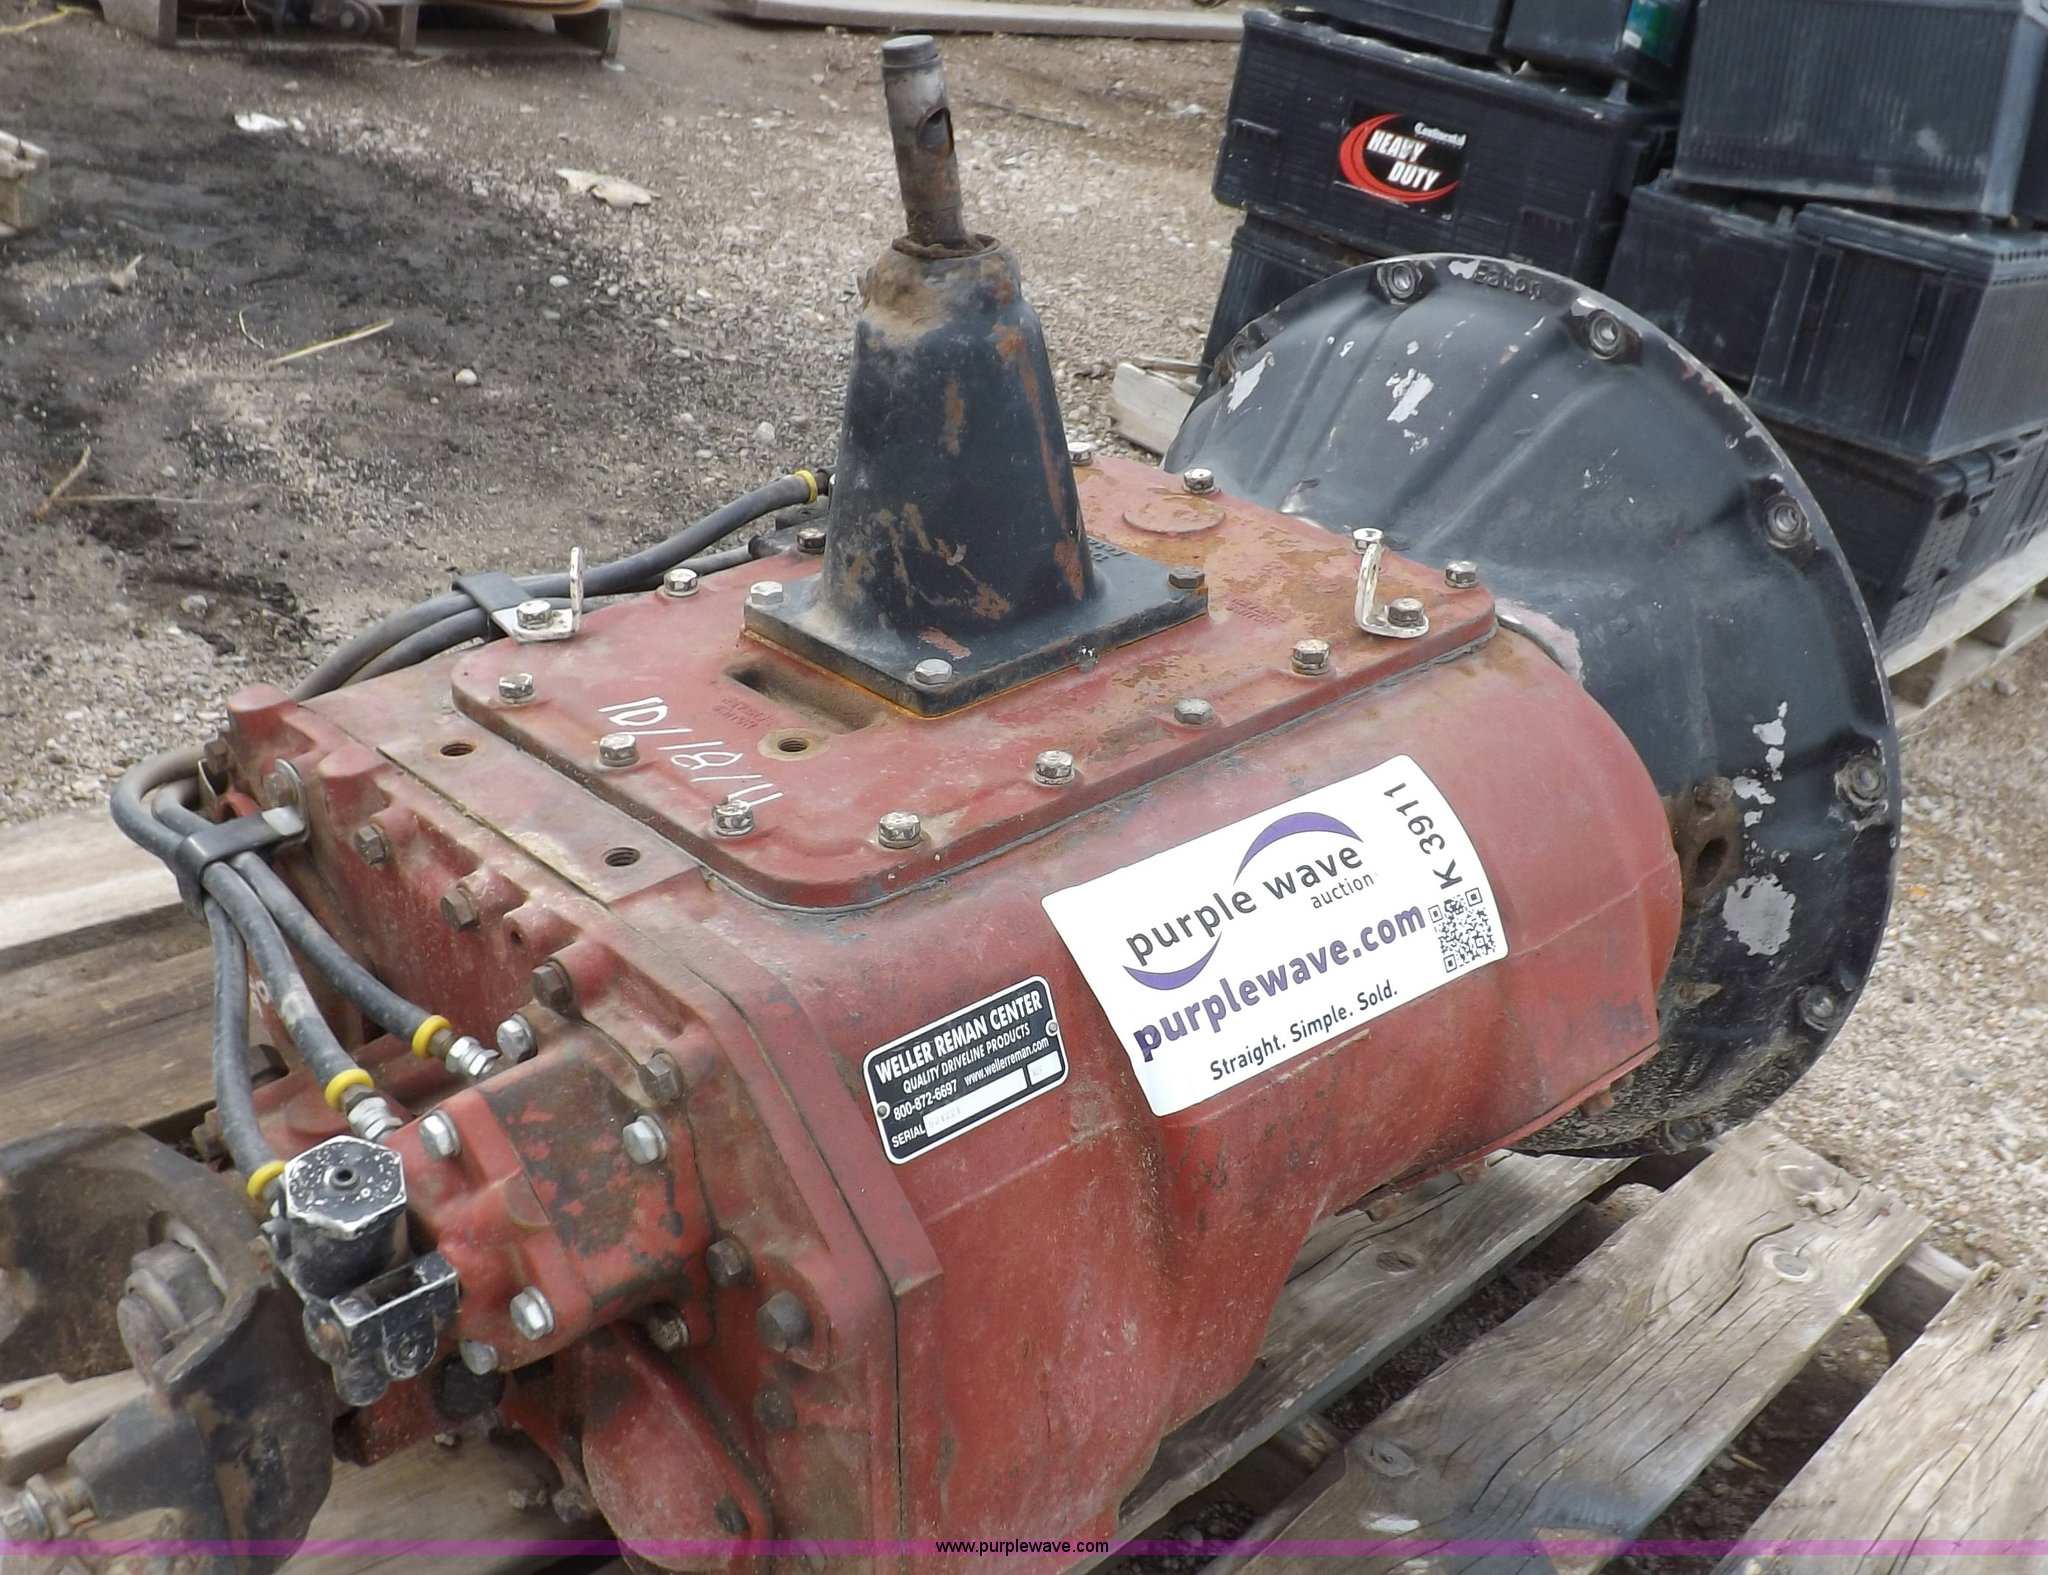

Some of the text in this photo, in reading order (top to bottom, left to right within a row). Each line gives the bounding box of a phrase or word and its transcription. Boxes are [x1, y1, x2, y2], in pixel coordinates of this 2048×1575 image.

[1366, 129, 1427, 163] HEAVY
[1387, 161, 1440, 192] DUTY
[1383, 782, 1463, 890] K 3911
[1125, 846, 1363, 967] purple wave
[1310, 873, 1375, 909] auction
[1132, 905, 1426, 1063] purplewave.com
[874, 990, 1043, 1085] WELLER REMAN CENTER
[902, 1022, 1031, 1094] QUALITY DRIVELINE PRODUCTS
[1210, 978, 1398, 1081] Straight. Simple. Sold.
[893, 1036, 1050, 1121] 800-872-6697 www.wellerreman.com
[891, 1123, 926, 1148] SERIAL
